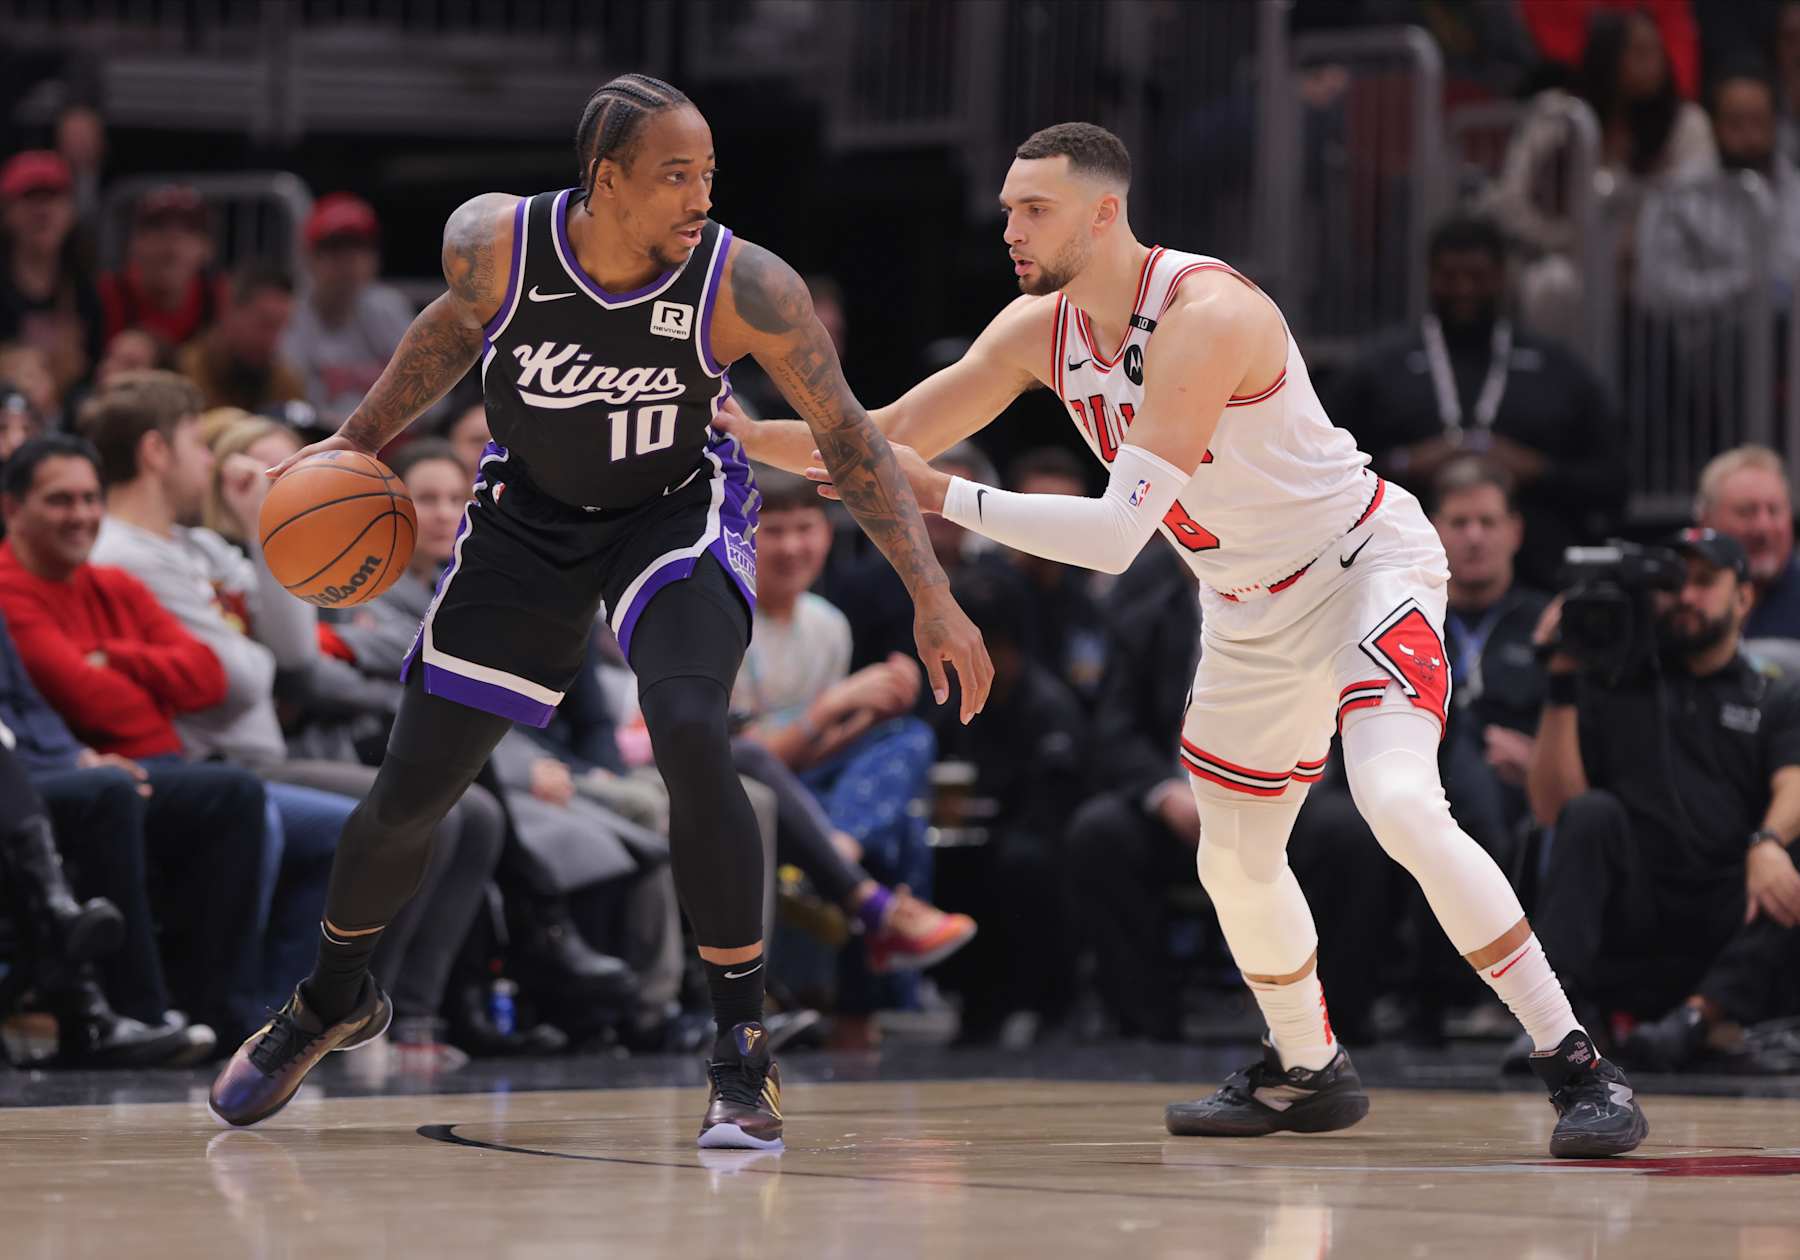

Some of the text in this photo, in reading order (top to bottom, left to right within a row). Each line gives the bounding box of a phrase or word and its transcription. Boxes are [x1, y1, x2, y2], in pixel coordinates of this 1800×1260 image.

[661, 306, 684, 327] R
[1137, 317, 1149, 330] 10
[652, 325, 687, 336] REVIVER
[512, 341, 687, 410] Kings
[607, 403, 679, 463] 10
